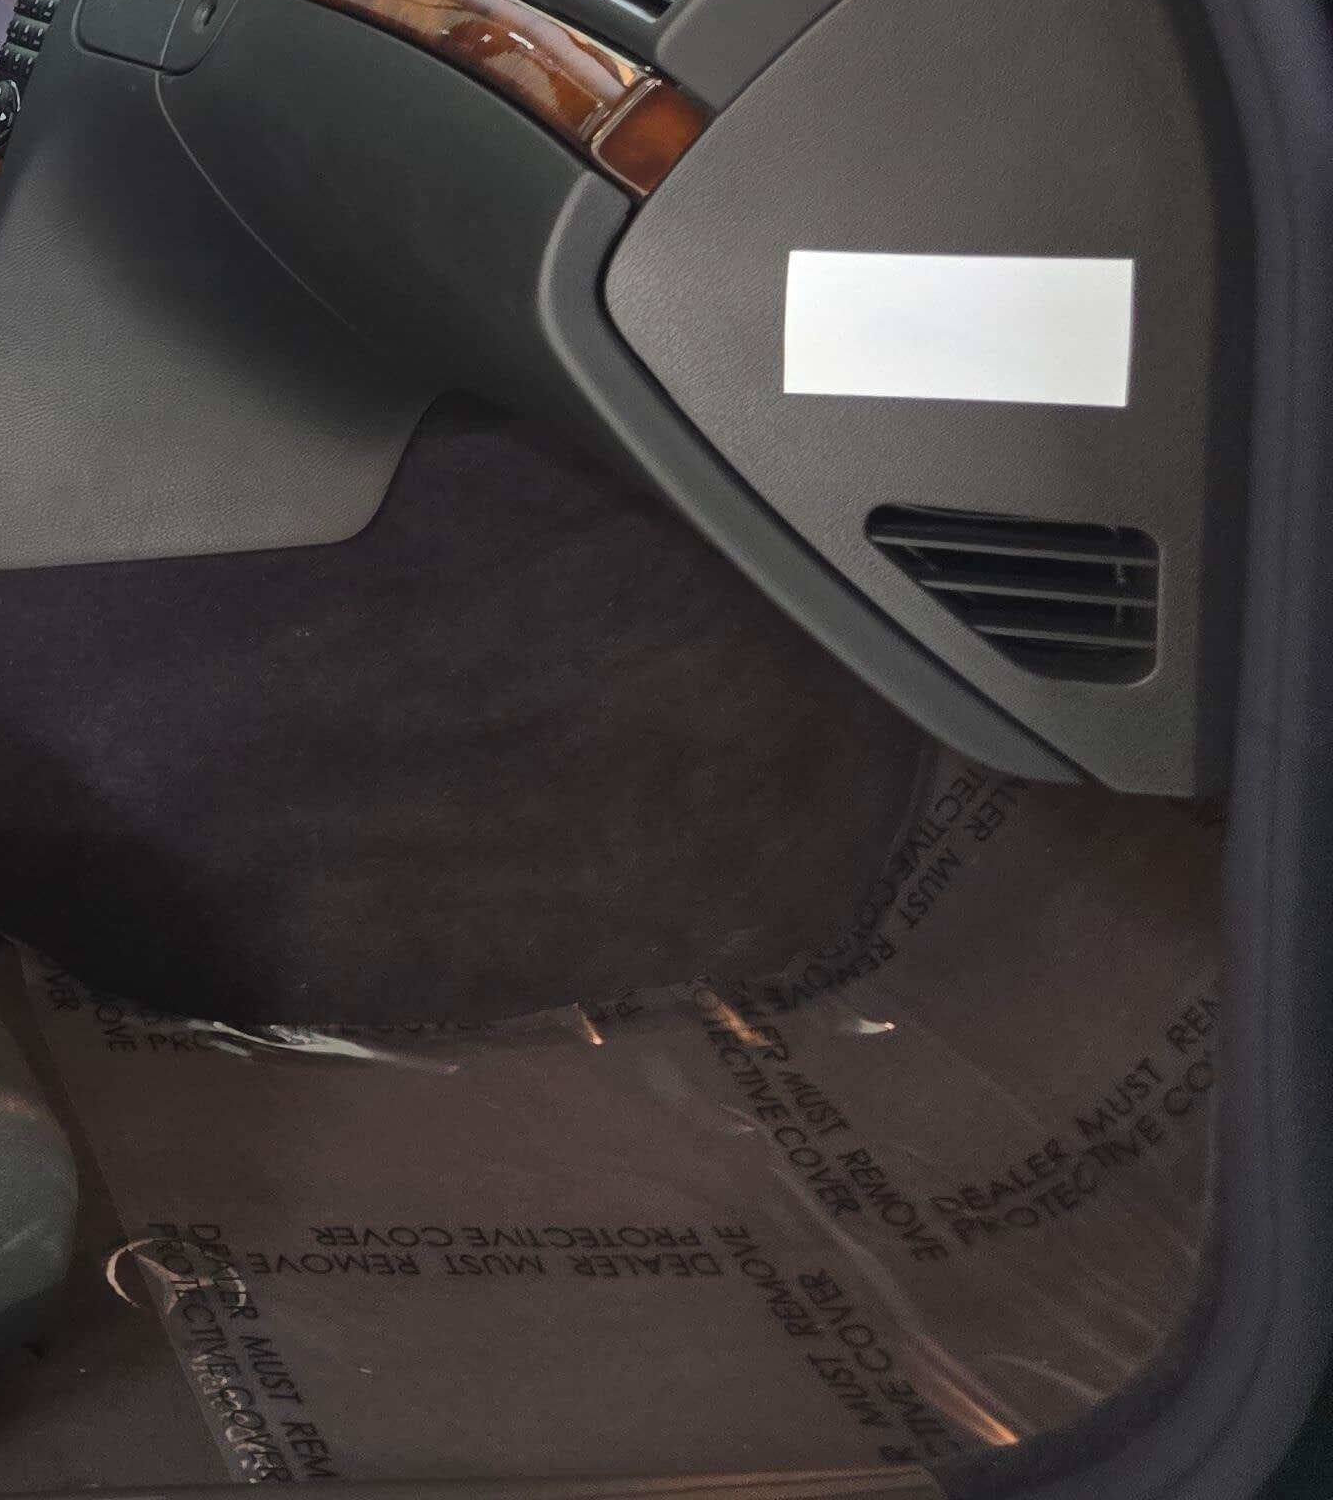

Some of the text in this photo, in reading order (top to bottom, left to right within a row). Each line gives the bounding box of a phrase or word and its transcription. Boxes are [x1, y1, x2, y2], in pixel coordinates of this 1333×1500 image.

[899, 848, 961, 928] MUST
[775, 1126, 861, 1216] COVER
[778, 1070, 851, 1136] MUST
[837, 1148, 949, 1262] REMOVE
[930, 1138, 1069, 1214] DEALER
[1076, 1058, 1163, 1138] MUST
[951, 1114, 1165, 1245] PROTECTIVE
[247, 1252, 723, 1277] DEALER MUST REMOVE
[309, 1226, 701, 1248] PROTECTIVE COVER
[147, 1223, 295, 1482] PROTECTIVE COVER
[189, 1224, 258, 1320] DEALER
[239, 1336, 303, 1404] MUST
[714, 1226, 893, 1428] MUST REMOVE
[798, 1268, 891, 1372] COVER
